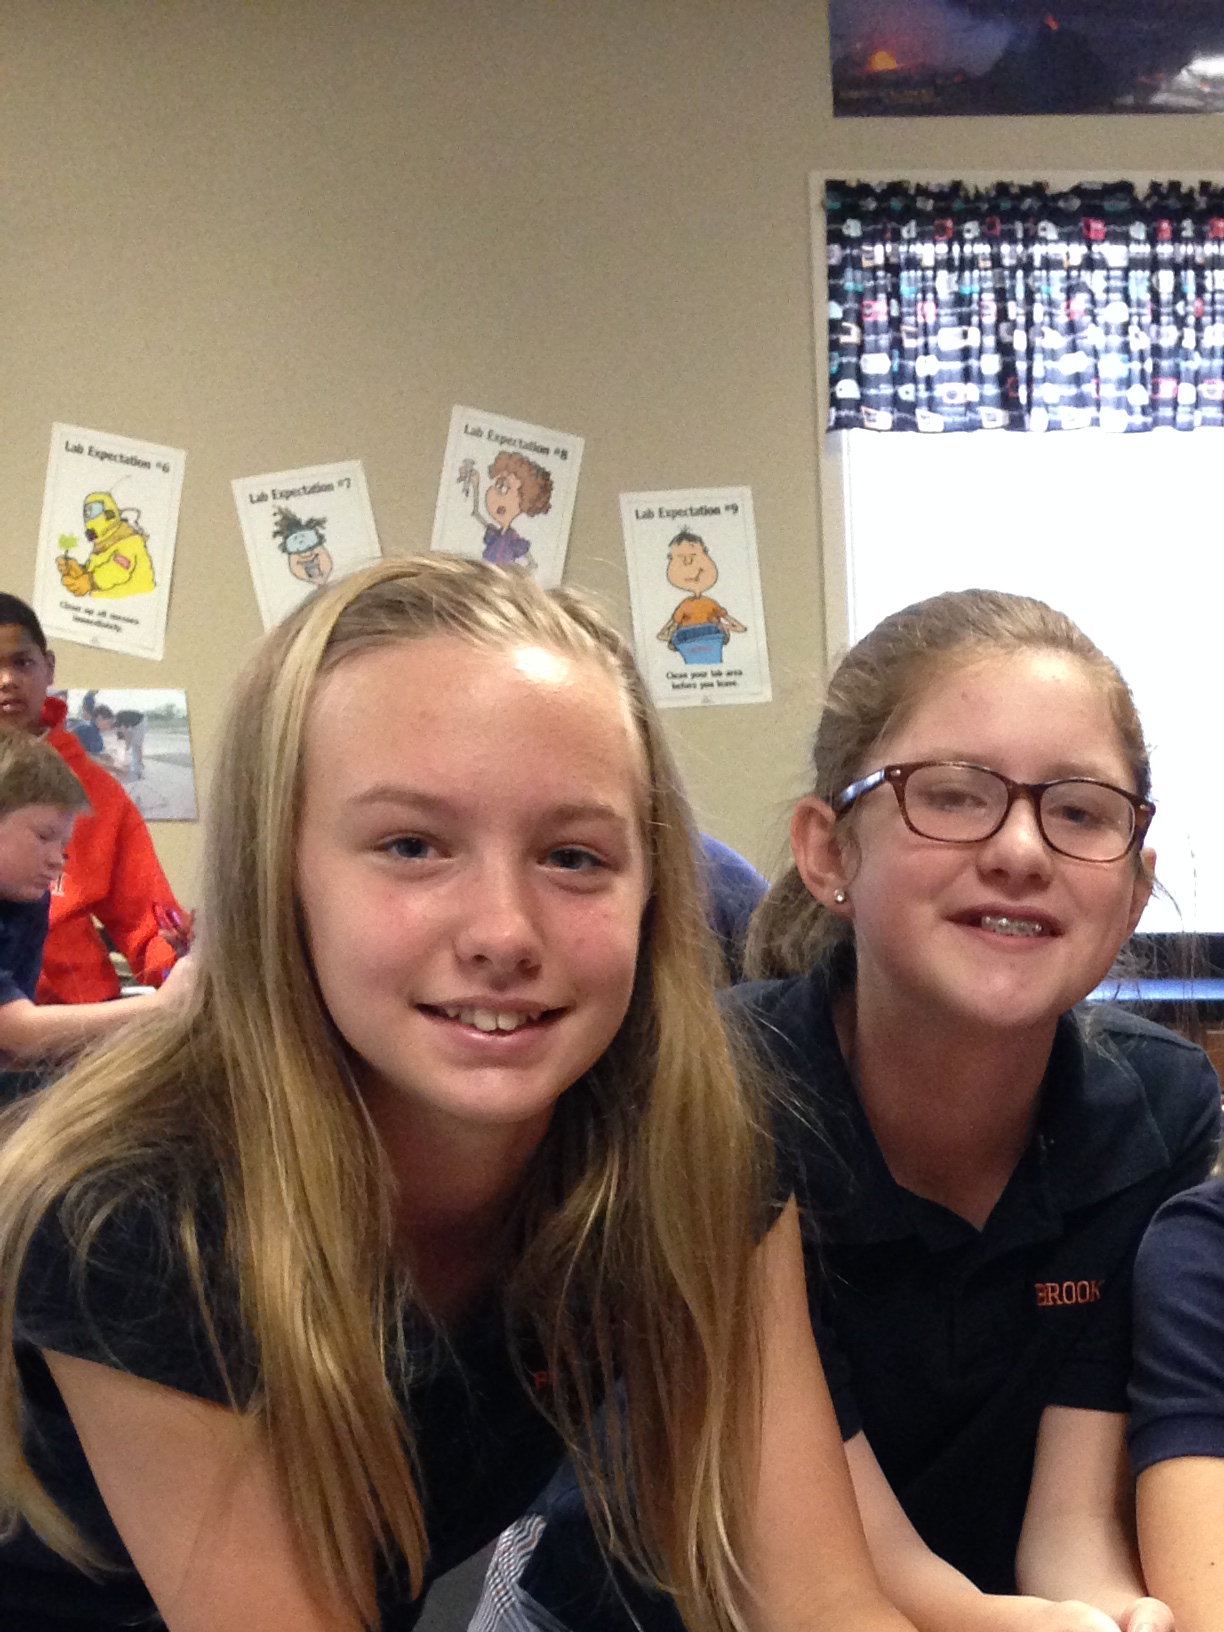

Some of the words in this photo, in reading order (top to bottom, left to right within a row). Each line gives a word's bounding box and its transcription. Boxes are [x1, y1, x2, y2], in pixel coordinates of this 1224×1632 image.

[463, 424, 484, 438] Lab
[64, 440, 85, 455] Lab
[248, 492, 269, 504] Lab
[635, 508, 655, 520] Lab
[658, 505, 721, 520] Expectation
